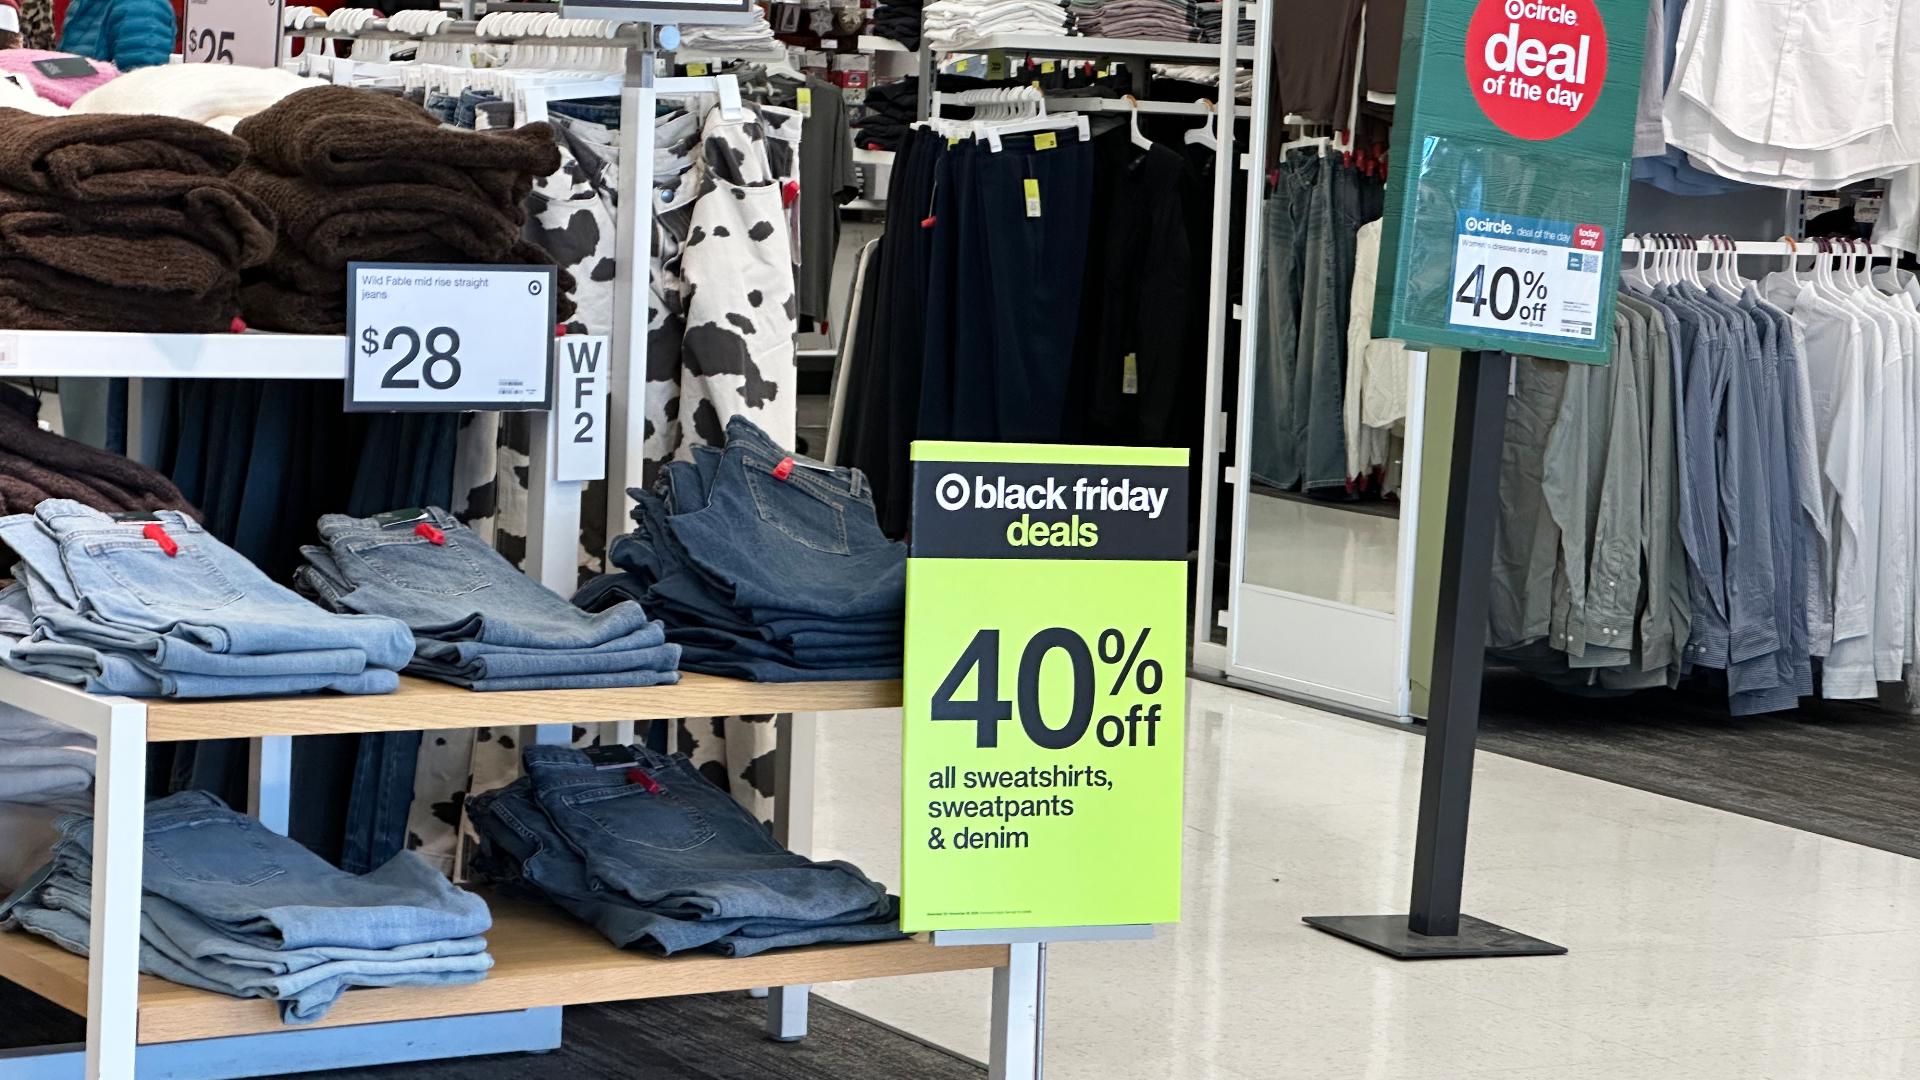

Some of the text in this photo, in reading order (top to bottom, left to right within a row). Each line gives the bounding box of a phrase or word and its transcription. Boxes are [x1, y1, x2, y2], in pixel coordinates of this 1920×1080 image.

[1525, 0, 1577, 26] circle
[1484, 22, 1590, 85] deal
[1482, 75, 1584, 112] of the day
[1461, 239, 1492, 249] Womens
[1477, 218, 1571, 244] circle deal of the day
[1578, 228, 1600, 240] today
[1580, 238, 1597, 249] only
[361, 290, 388, 300] jeans
[362, 275, 489, 290] Wild Fable mid rise straight
[1519, 303, 1547, 322] off
[361, 325, 462, 390] $28
[974, 475, 1169, 519] black friday
[1006, 513, 1099, 547] deals
[1095, 703, 1162, 748] off
[928, 764, 1113, 791] all sweatshirts,
[927, 795, 1074, 822] sweatpants
[927, 825, 1030, 850] & denim
